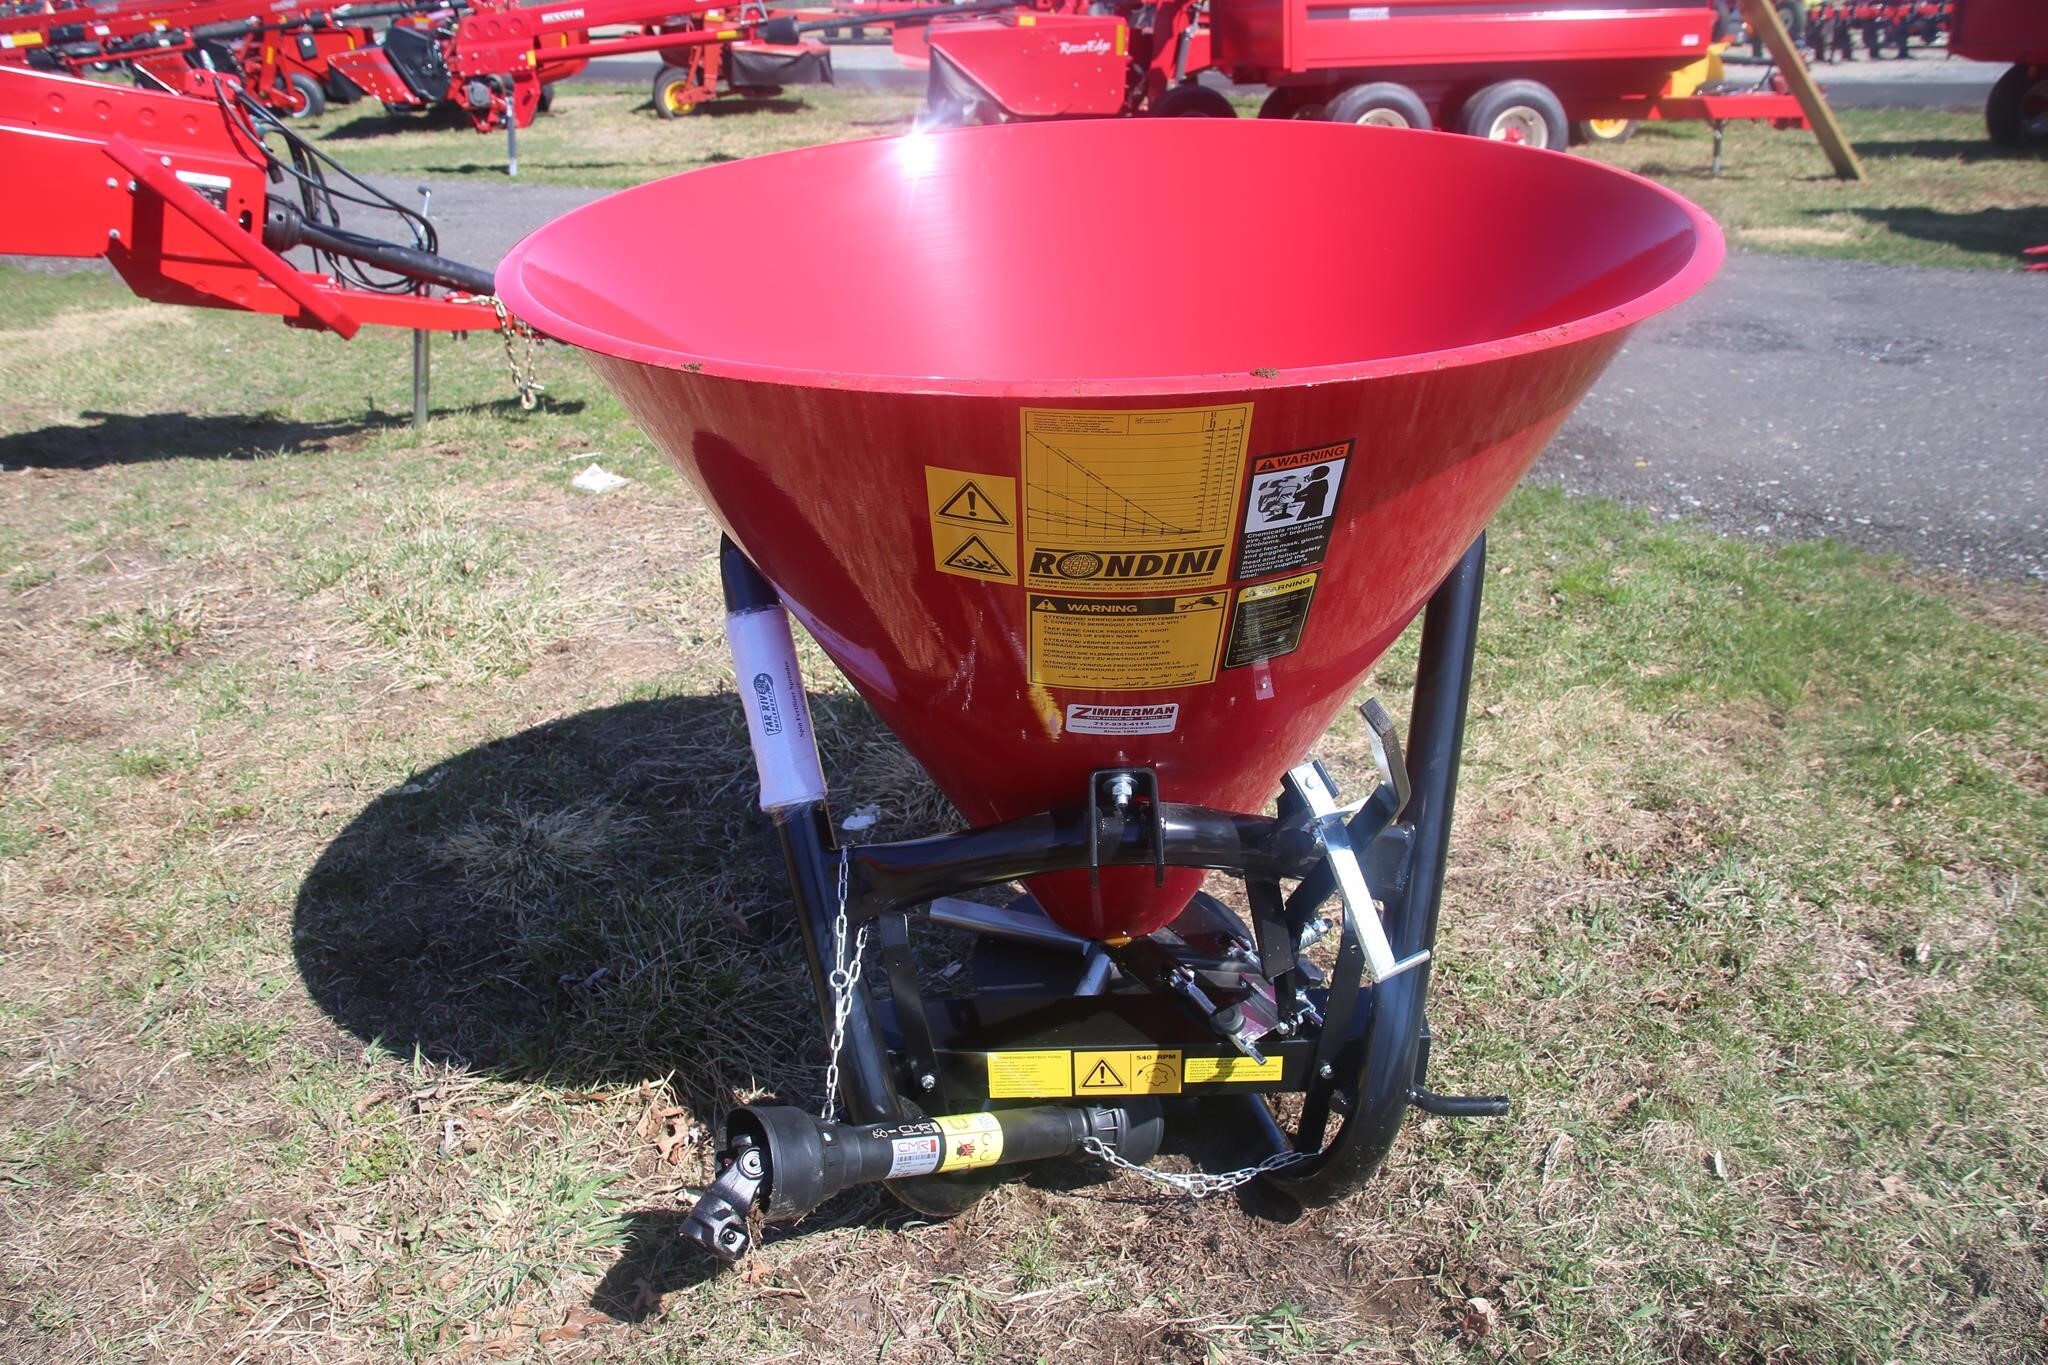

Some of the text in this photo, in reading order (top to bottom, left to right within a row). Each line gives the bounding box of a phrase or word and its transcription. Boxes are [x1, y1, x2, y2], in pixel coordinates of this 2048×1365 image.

[1277, 446, 1345, 467] WARNING
[1247, 520, 1325, 539] Chemicals may cause
[1289, 524, 1323, 536] breathing
[1245, 539, 1281, 549] problems.
[1278, 551, 1298, 560] follow
[1300, 545, 1321, 554] safety
[1030, 548, 1224, 580] RONDINI
[1241, 565, 1274, 574] chemical
[1067, 604, 1138, 612] WARNING
[758, 682, 774, 732] TAR RIVER
[1071, 706, 1175, 719] ZIMMERMAN
[900, 1122, 932, 1133] CMR
[898, 1140, 929, 1152] CMR
